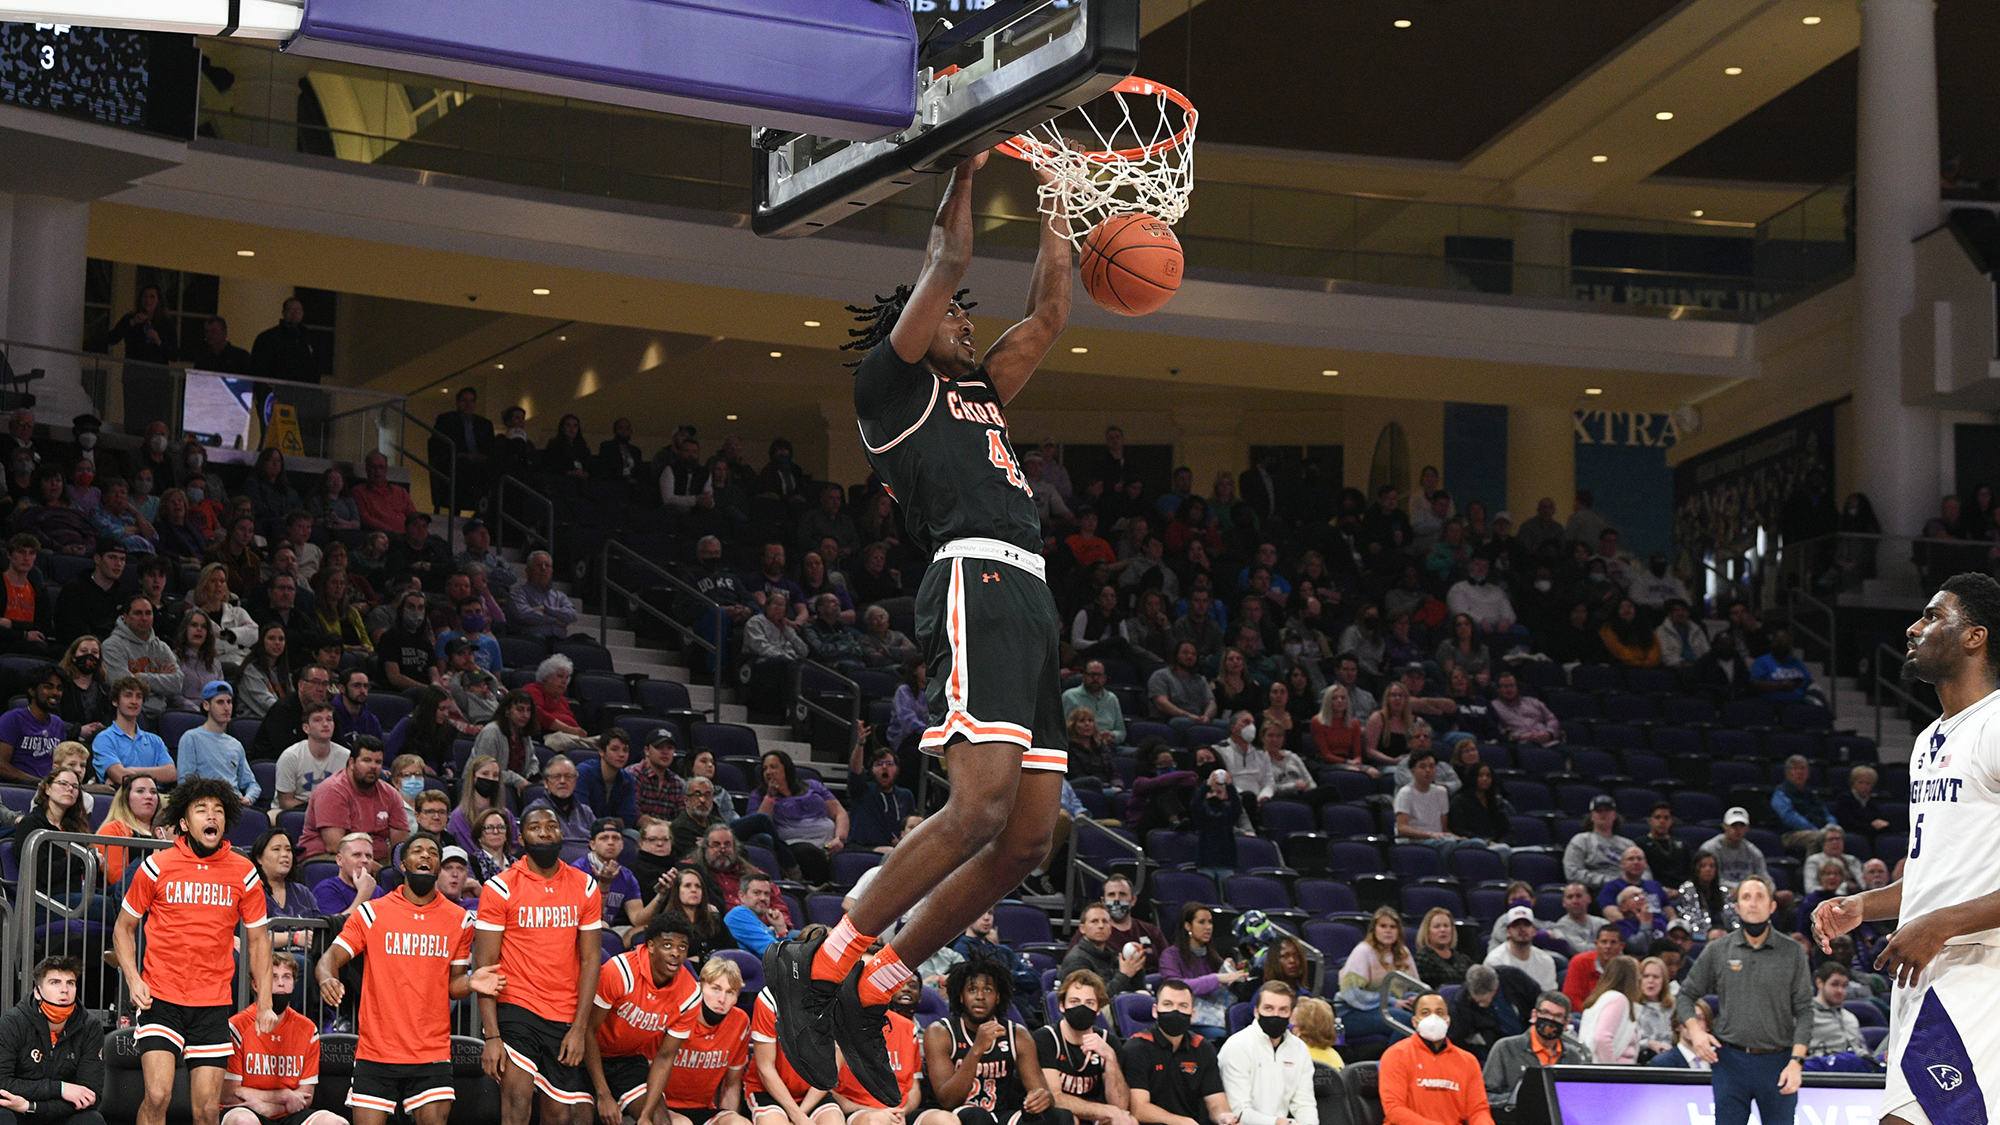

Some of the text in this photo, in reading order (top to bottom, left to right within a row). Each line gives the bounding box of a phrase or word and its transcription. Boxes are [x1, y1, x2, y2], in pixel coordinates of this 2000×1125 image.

[40, 44, 55, 70] 3
[20, 736, 42, 750] HIGH
[1923, 778, 1963, 803] POINT
[1910, 813, 1925, 859] 5
[166, 881, 233, 907] CAMPBELL
[518, 905, 579, 928] CAMPBELL
[385, 931, 449, 958] CAMPBELL
[616, 1001, 669, 1034] CAMPBELL
[673, 1048, 730, 1070] CAMPBELL
[955, 1058, 1007, 1078] CPBELL
[962, 1079, 997, 1112] 23
